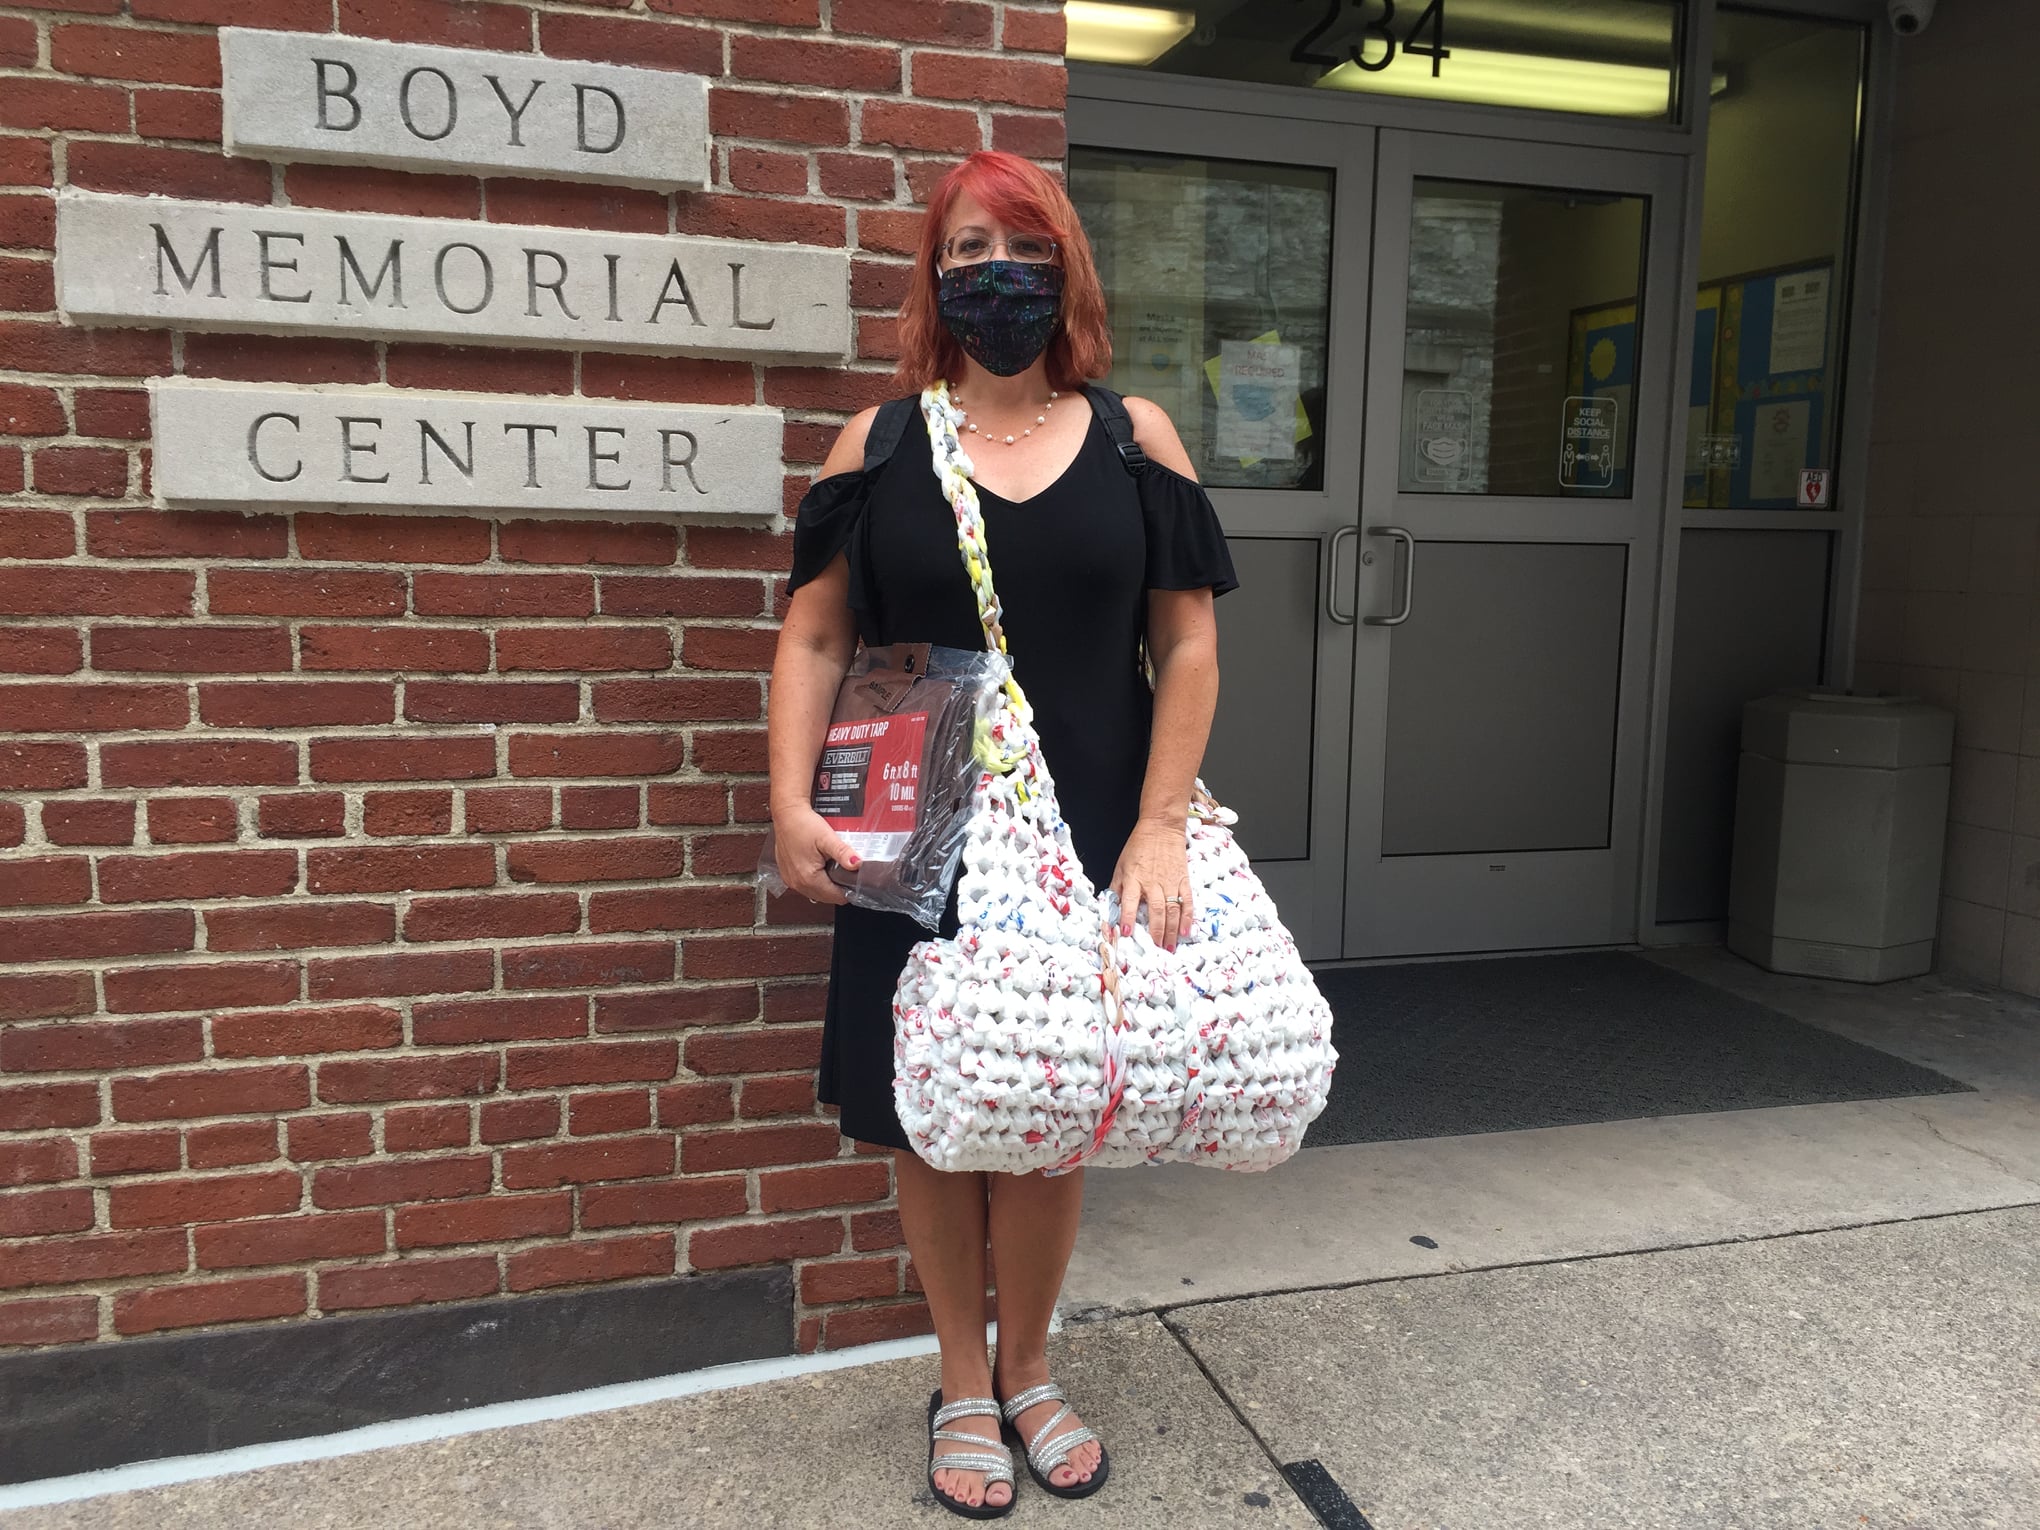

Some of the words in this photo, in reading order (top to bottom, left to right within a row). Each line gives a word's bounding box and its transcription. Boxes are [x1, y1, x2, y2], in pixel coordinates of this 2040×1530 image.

[1290, 0, 1450, 77] 234
[311, 58, 627, 154] BOYD
[148, 222, 777, 331] MEMORIAL
[1579, 407, 1602, 417] KEEP
[1573, 417, 1605, 427] SOCIAL
[1567, 427, 1611, 437] DISTANCE
[246, 412, 709, 495] CENTER
[1806, 472, 1823, 482] AED
[827, 726, 852, 743] HEAVY
[850, 724, 871, 740] DUTY
[870, 721, 889, 738] TARP
[825, 750, 869, 765] EVERBILT
[883, 762, 890, 780] 6
[889, 766, 897, 780] ft
[902, 760, 910, 779] 8
[911, 764, 918, 779] ft
[890, 782, 900, 801] 10
[900, 785, 915, 801] MIL
